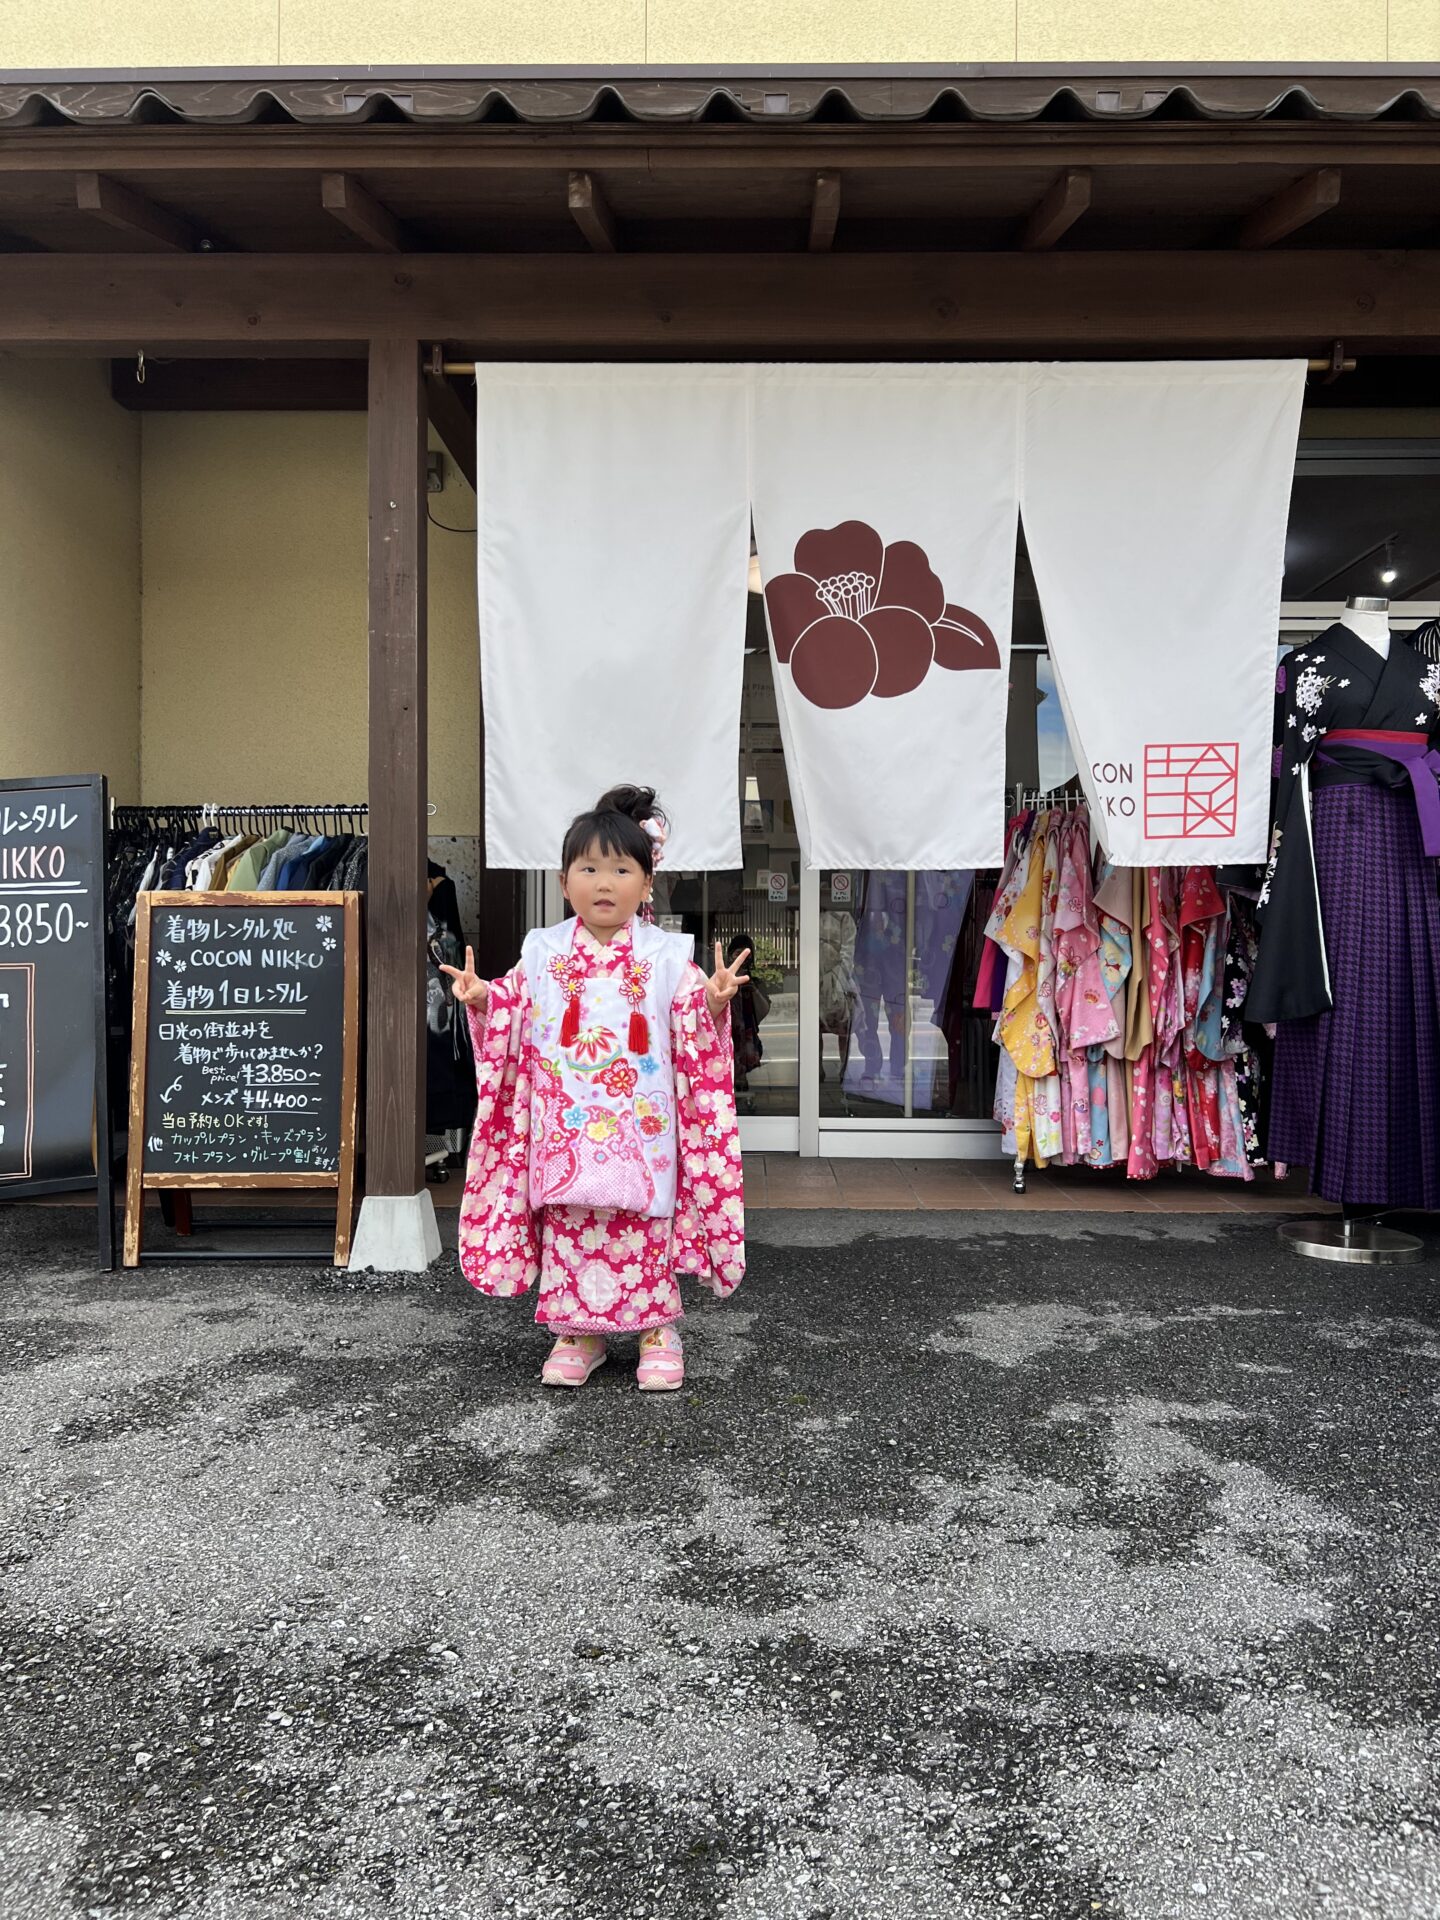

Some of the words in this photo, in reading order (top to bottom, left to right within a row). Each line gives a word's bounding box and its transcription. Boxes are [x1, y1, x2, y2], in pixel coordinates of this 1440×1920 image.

[1092, 763, 1132, 783] CON
[1100, 797, 1135, 816] KO
[0, 803, 78, 835] レンタル
[3, 845, 65, 879] IKKO
[165, 914, 297, 943] 着物レンタル処
[190, 949, 252, 968] COCON
[158, 1020, 274, 1040] 日光の街並みを
[174, 1042, 324, 1064] 着物で歩いてみませんか?
[202, 1065, 226, 1075] Best
[201, 1088, 239, 1106] メンズ
[147, 1135, 163, 1152] 他
